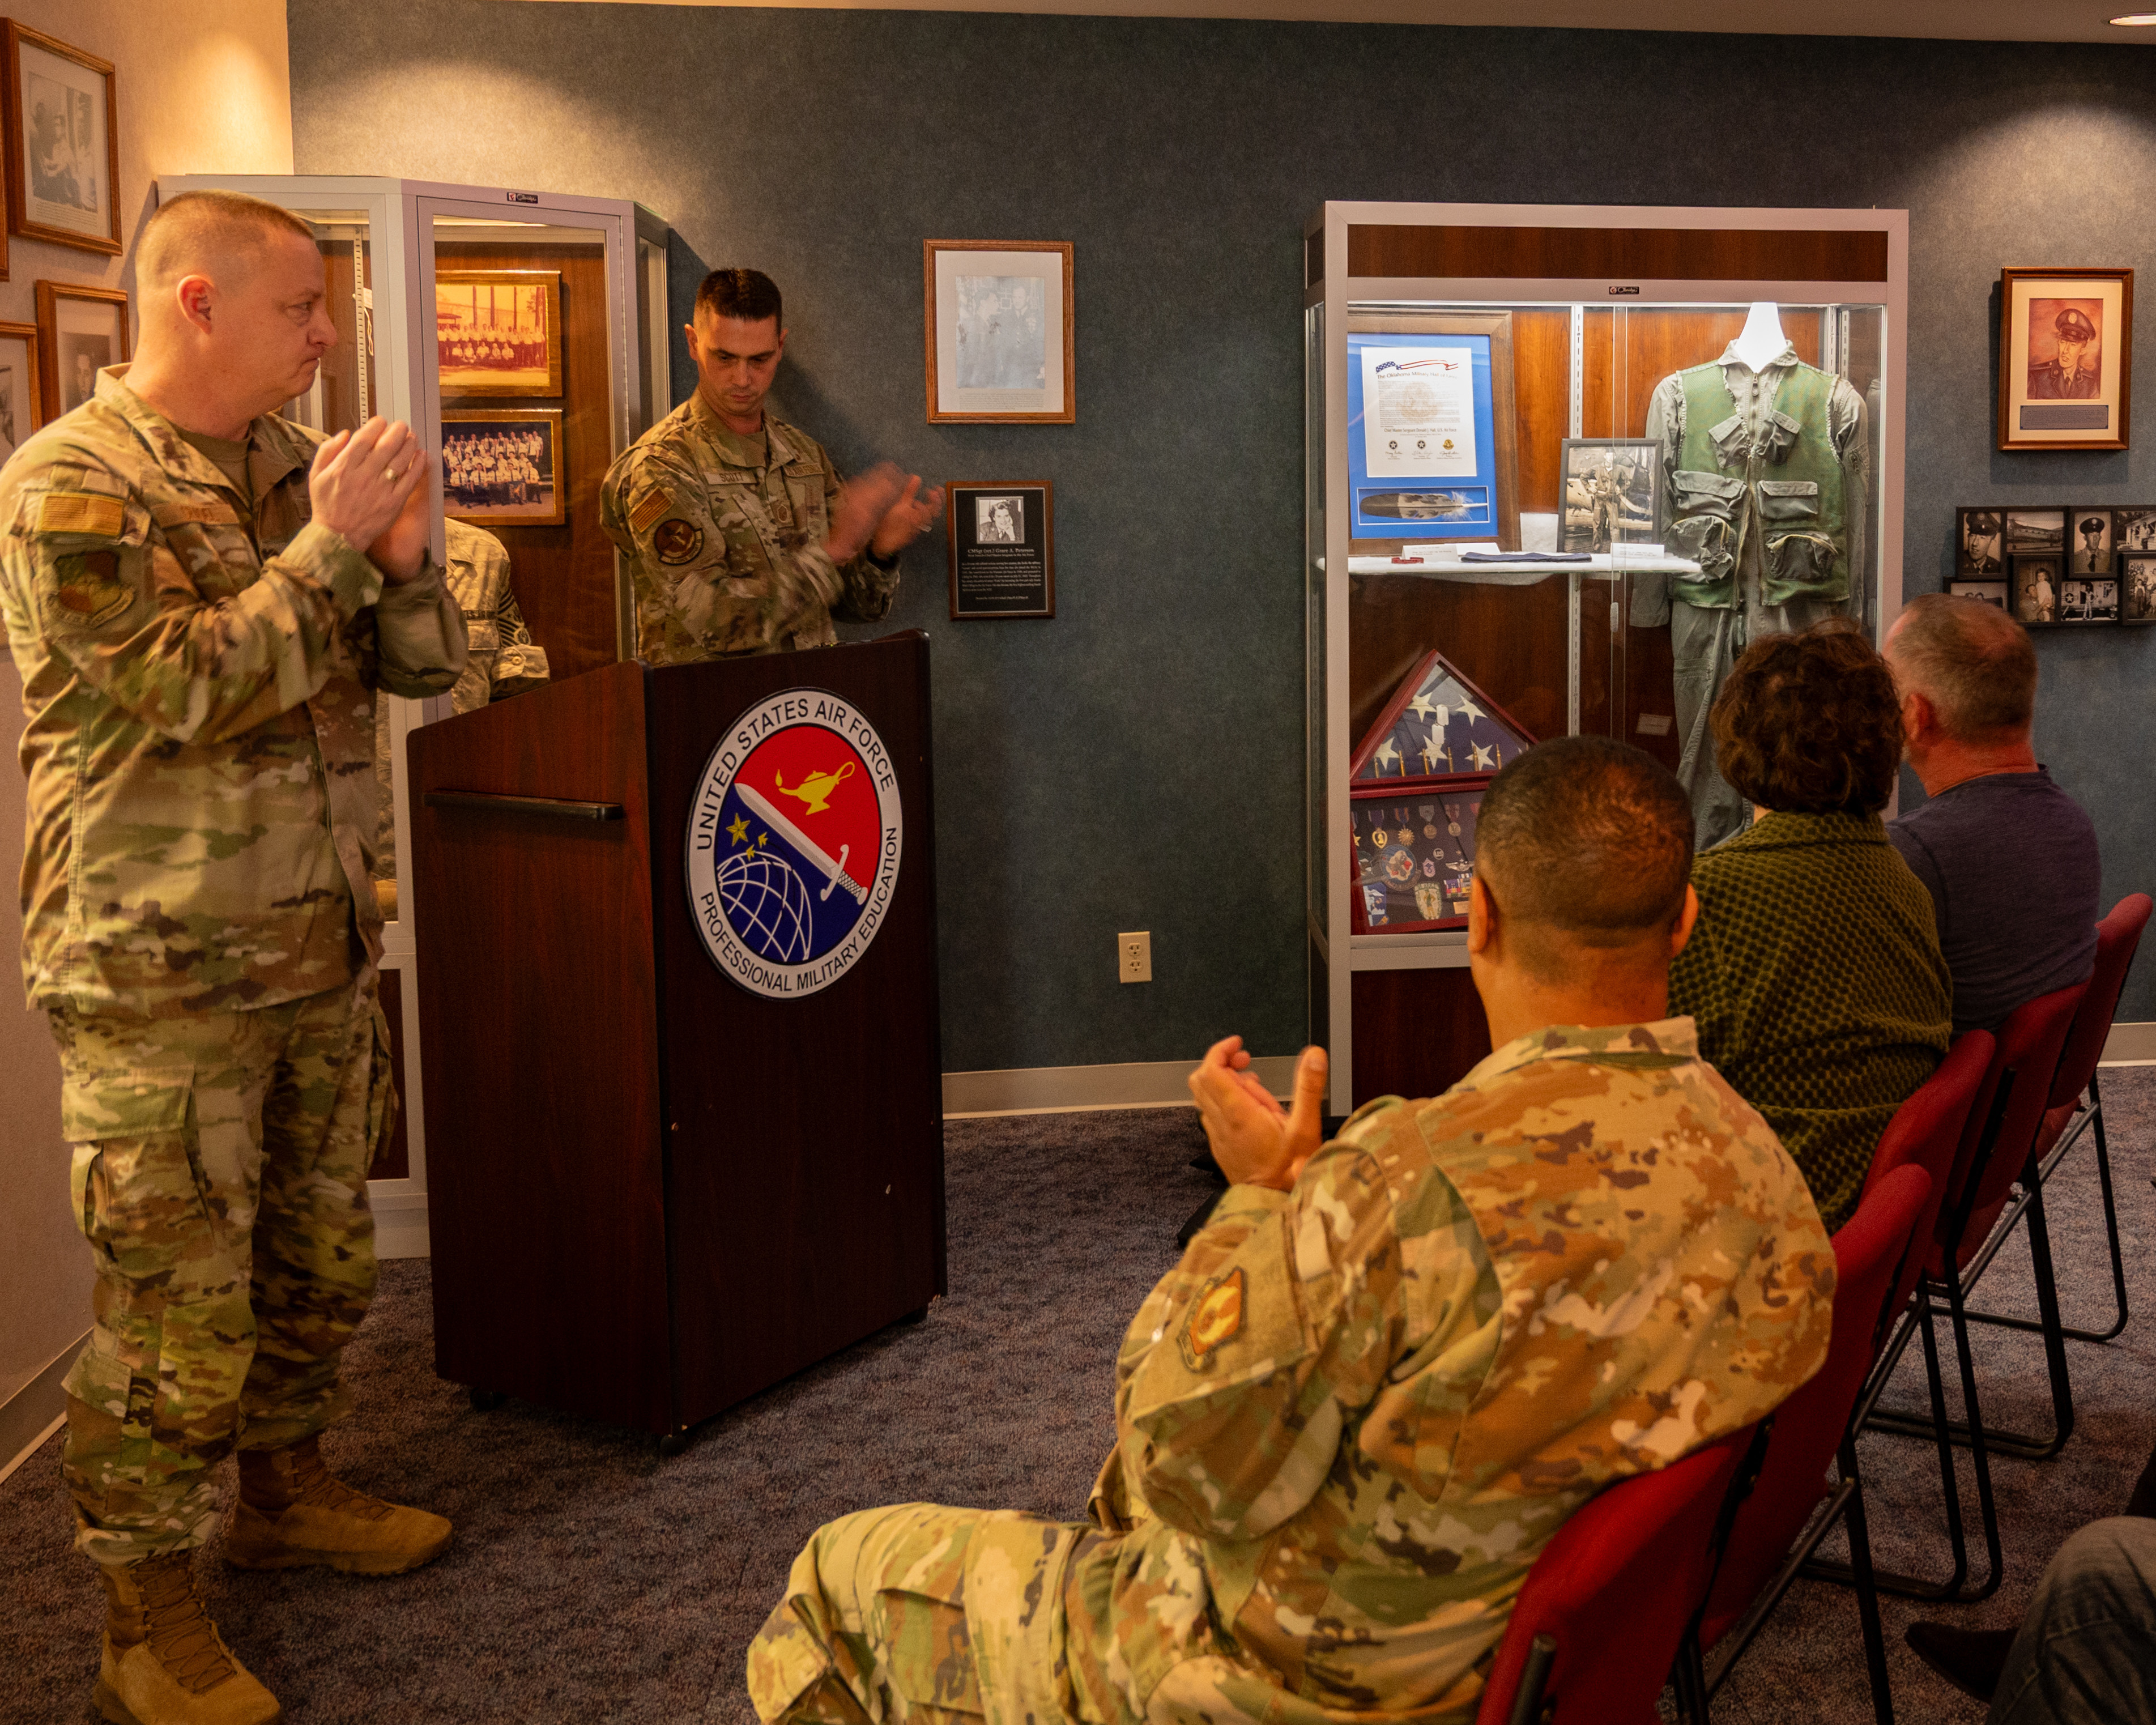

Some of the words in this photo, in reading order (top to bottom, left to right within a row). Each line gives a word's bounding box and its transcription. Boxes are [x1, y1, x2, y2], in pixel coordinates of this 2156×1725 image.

[719, 471, 744, 482] SCOTT
[697, 751, 738, 850] UNITED
[738, 698, 809, 750] STATES
[815, 700, 847, 727] AIR
[849, 717, 894, 792] FORCE
[701, 891, 792, 991] PROFESSIONAL
[796, 936, 863, 990] MILITARY
[861, 827, 897, 942] EDUCATION
